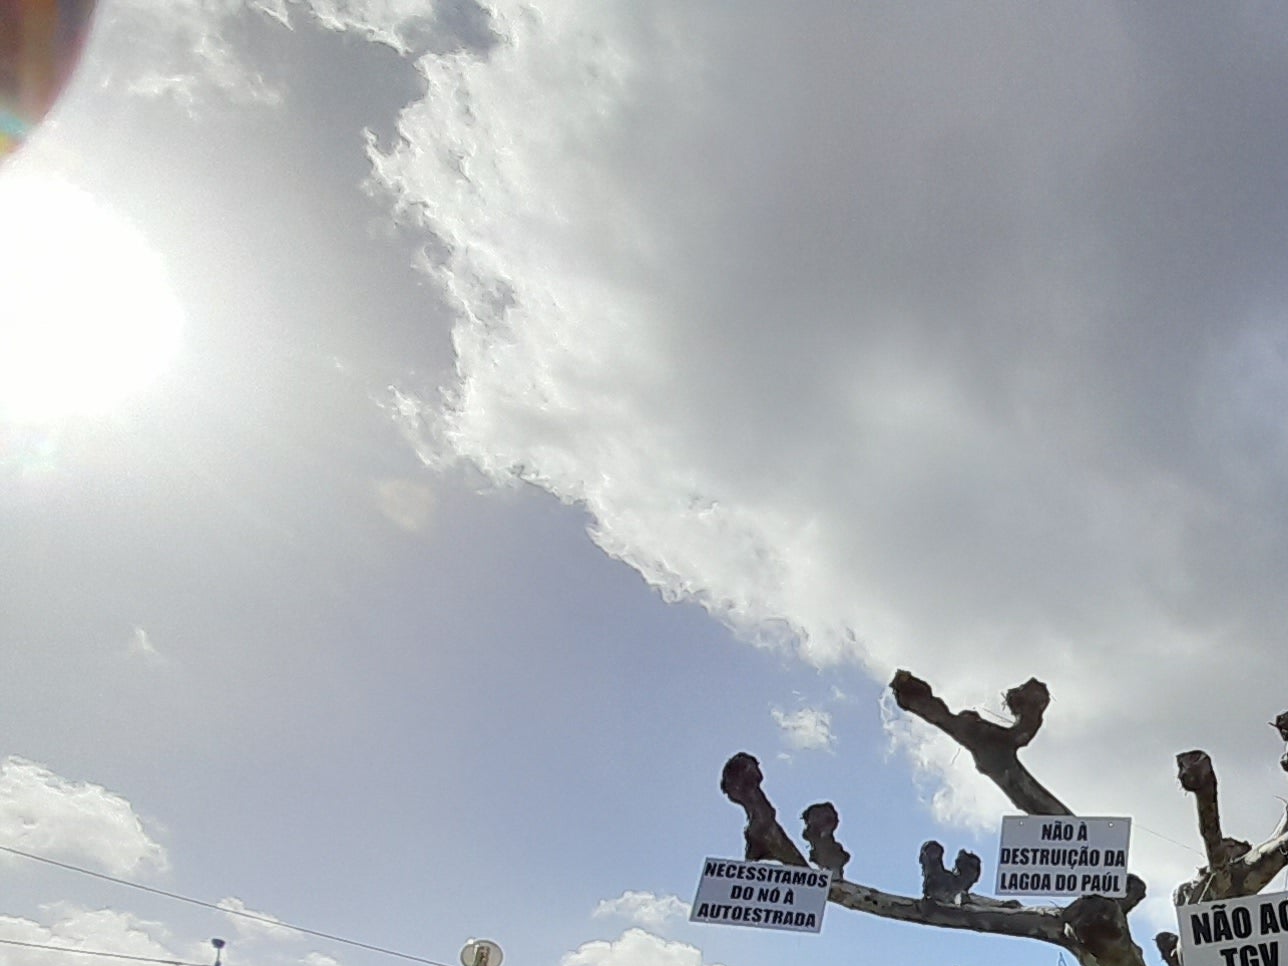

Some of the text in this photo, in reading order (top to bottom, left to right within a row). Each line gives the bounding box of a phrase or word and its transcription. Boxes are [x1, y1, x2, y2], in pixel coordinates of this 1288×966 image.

[1041, 820, 1088, 841] NÃO À
[1000, 846, 1126, 869] DESTRUIÇÃO DA
[704, 862, 828, 888] NECESSITAMOS
[1000, 872, 1120, 893] LAGOA DO PAÚL
[730, 885, 754, 900] DO
[757, 887, 780, 903] NÓ
[697, 903, 816, 928] AUTOESTRADA
[1190, 904, 1252, 945] NÃO
